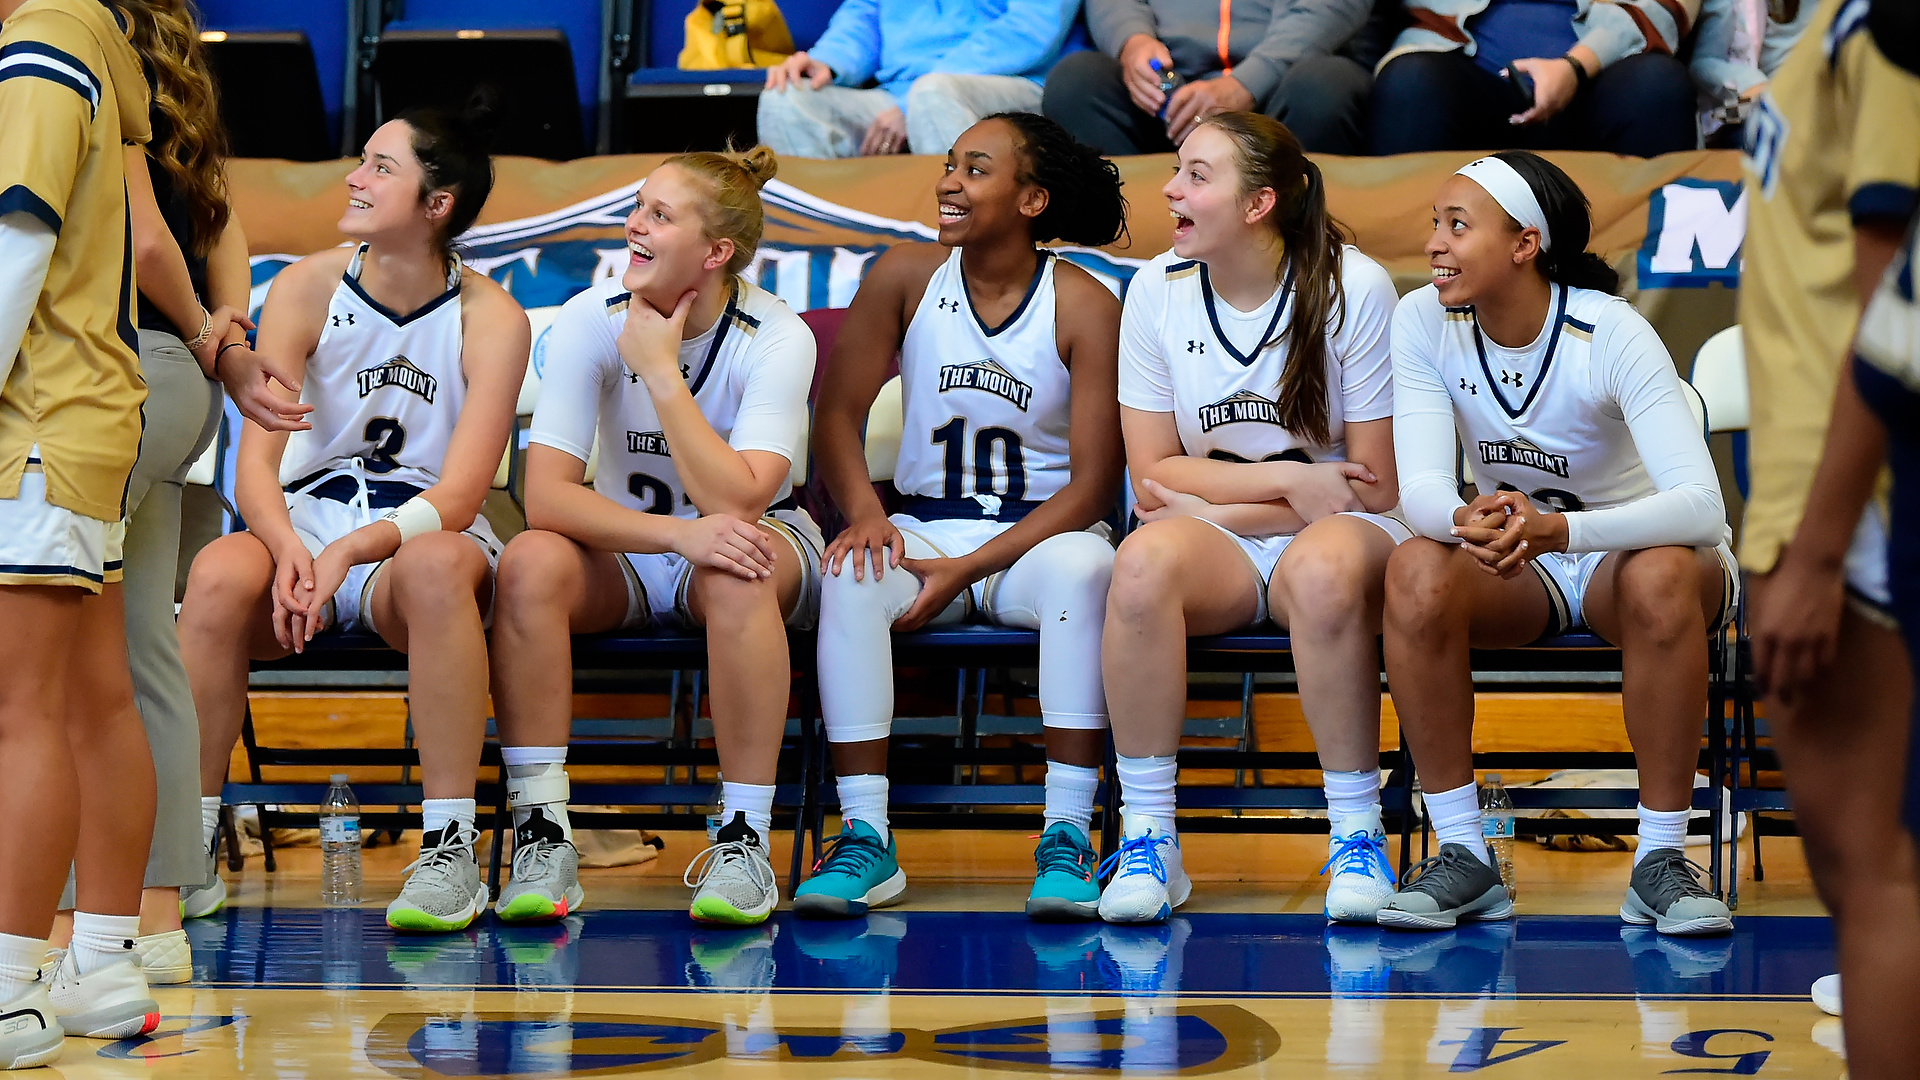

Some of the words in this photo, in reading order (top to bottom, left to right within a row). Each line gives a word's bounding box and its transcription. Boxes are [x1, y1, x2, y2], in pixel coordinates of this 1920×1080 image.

[358, 368, 385, 396] THE
[386, 366, 437, 402] MOUNT
[941, 366, 972, 390] THE
[976, 369, 1031, 409] MOUNT
[1200, 404, 1231, 431] THE
[1234, 401, 1283, 423] MOUN
[628, 432, 656, 452] THE
[931, 415, 1029, 500] 10
[1479, 442, 1508, 463] THE
[1511, 446, 1567, 476] MOUNT
[1438, 1027, 1569, 1072] 4
[1659, 1028, 1774, 1075] 5
